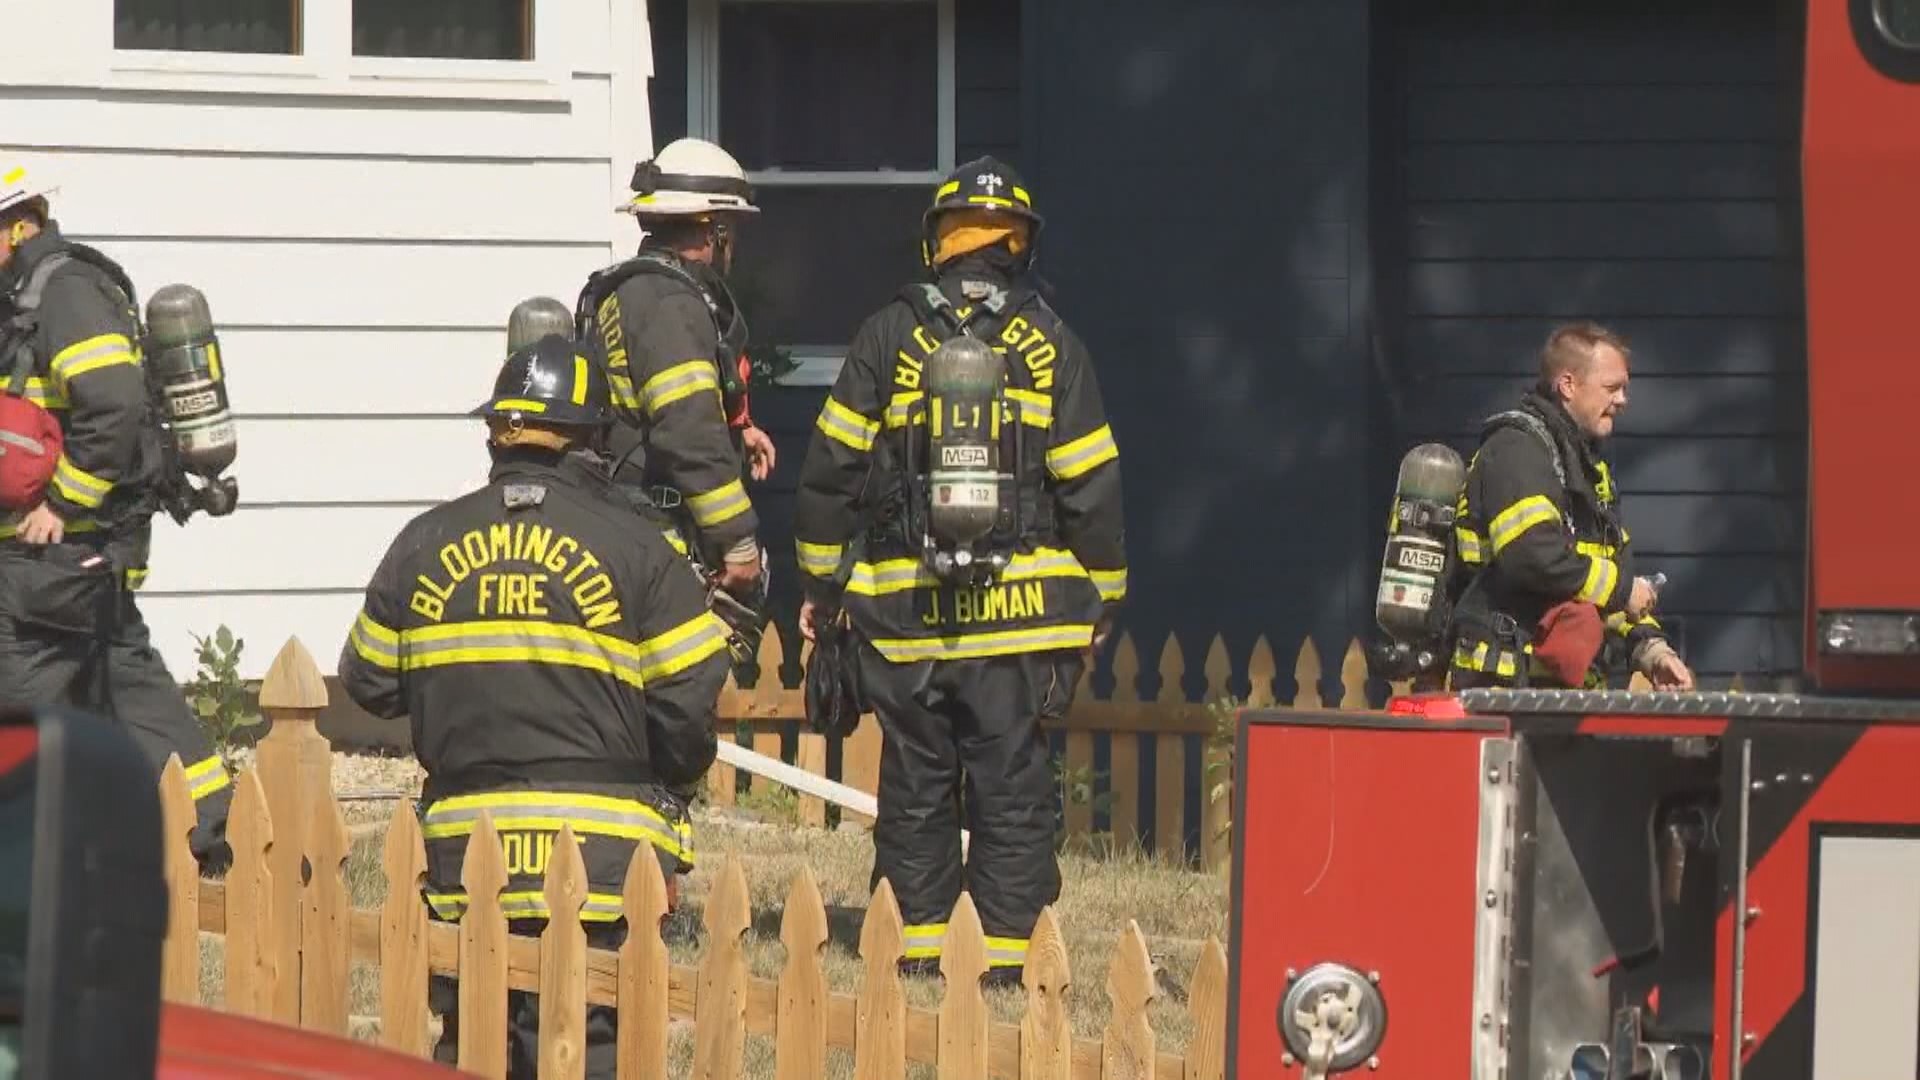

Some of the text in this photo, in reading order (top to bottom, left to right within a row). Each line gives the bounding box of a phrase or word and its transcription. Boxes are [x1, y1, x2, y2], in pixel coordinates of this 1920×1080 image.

[952, 404, 980, 429] L1
[944, 449, 986, 463] MSA
[409, 522, 623, 629] BLOOMINGTON
[1402, 551, 1442, 569] MSA
[478, 573, 549, 616] FIRE
[922, 580, 1045, 625] J. BOMAN
